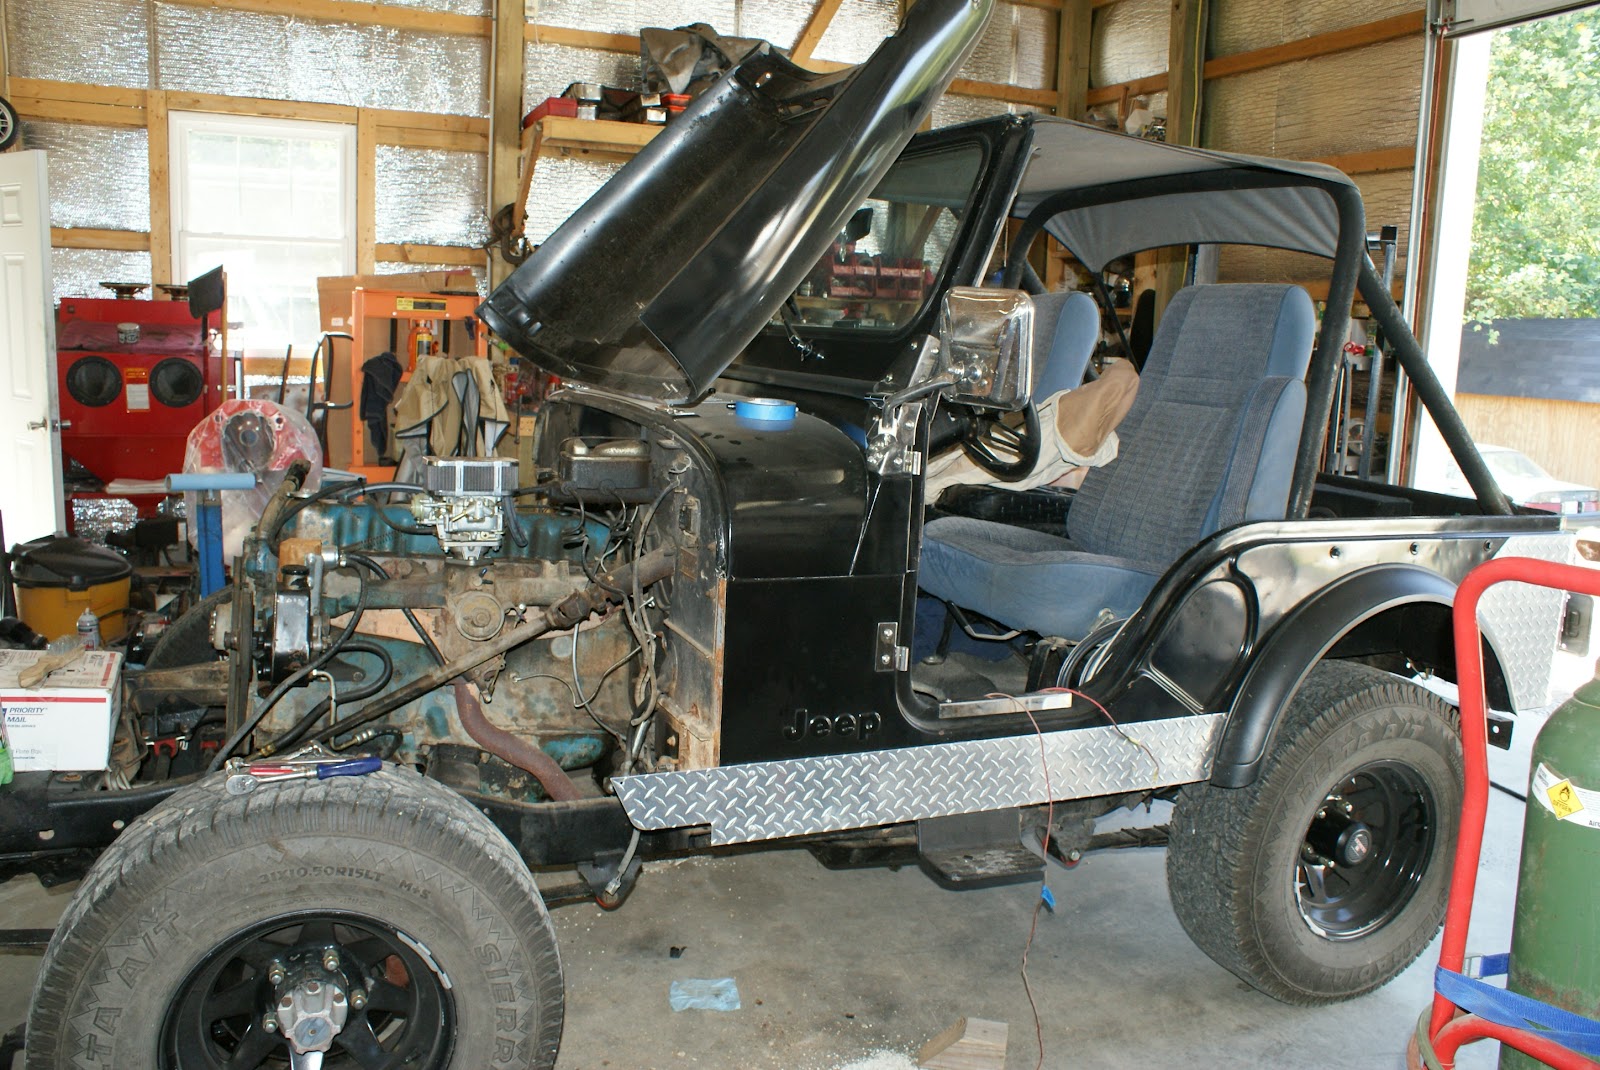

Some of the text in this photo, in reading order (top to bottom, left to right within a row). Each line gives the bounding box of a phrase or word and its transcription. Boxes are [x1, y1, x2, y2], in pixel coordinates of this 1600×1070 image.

[9, 706, 45, 714] PRIORITY
[782, 708, 881, 741] Jeep
[1382, 722, 1425, 740] A/T
[1552, 799, 1572, 813] OXYGEN
[257, 865, 432, 899] 31X10.50R15LT M+S
[116, 901, 180, 990] A/T
